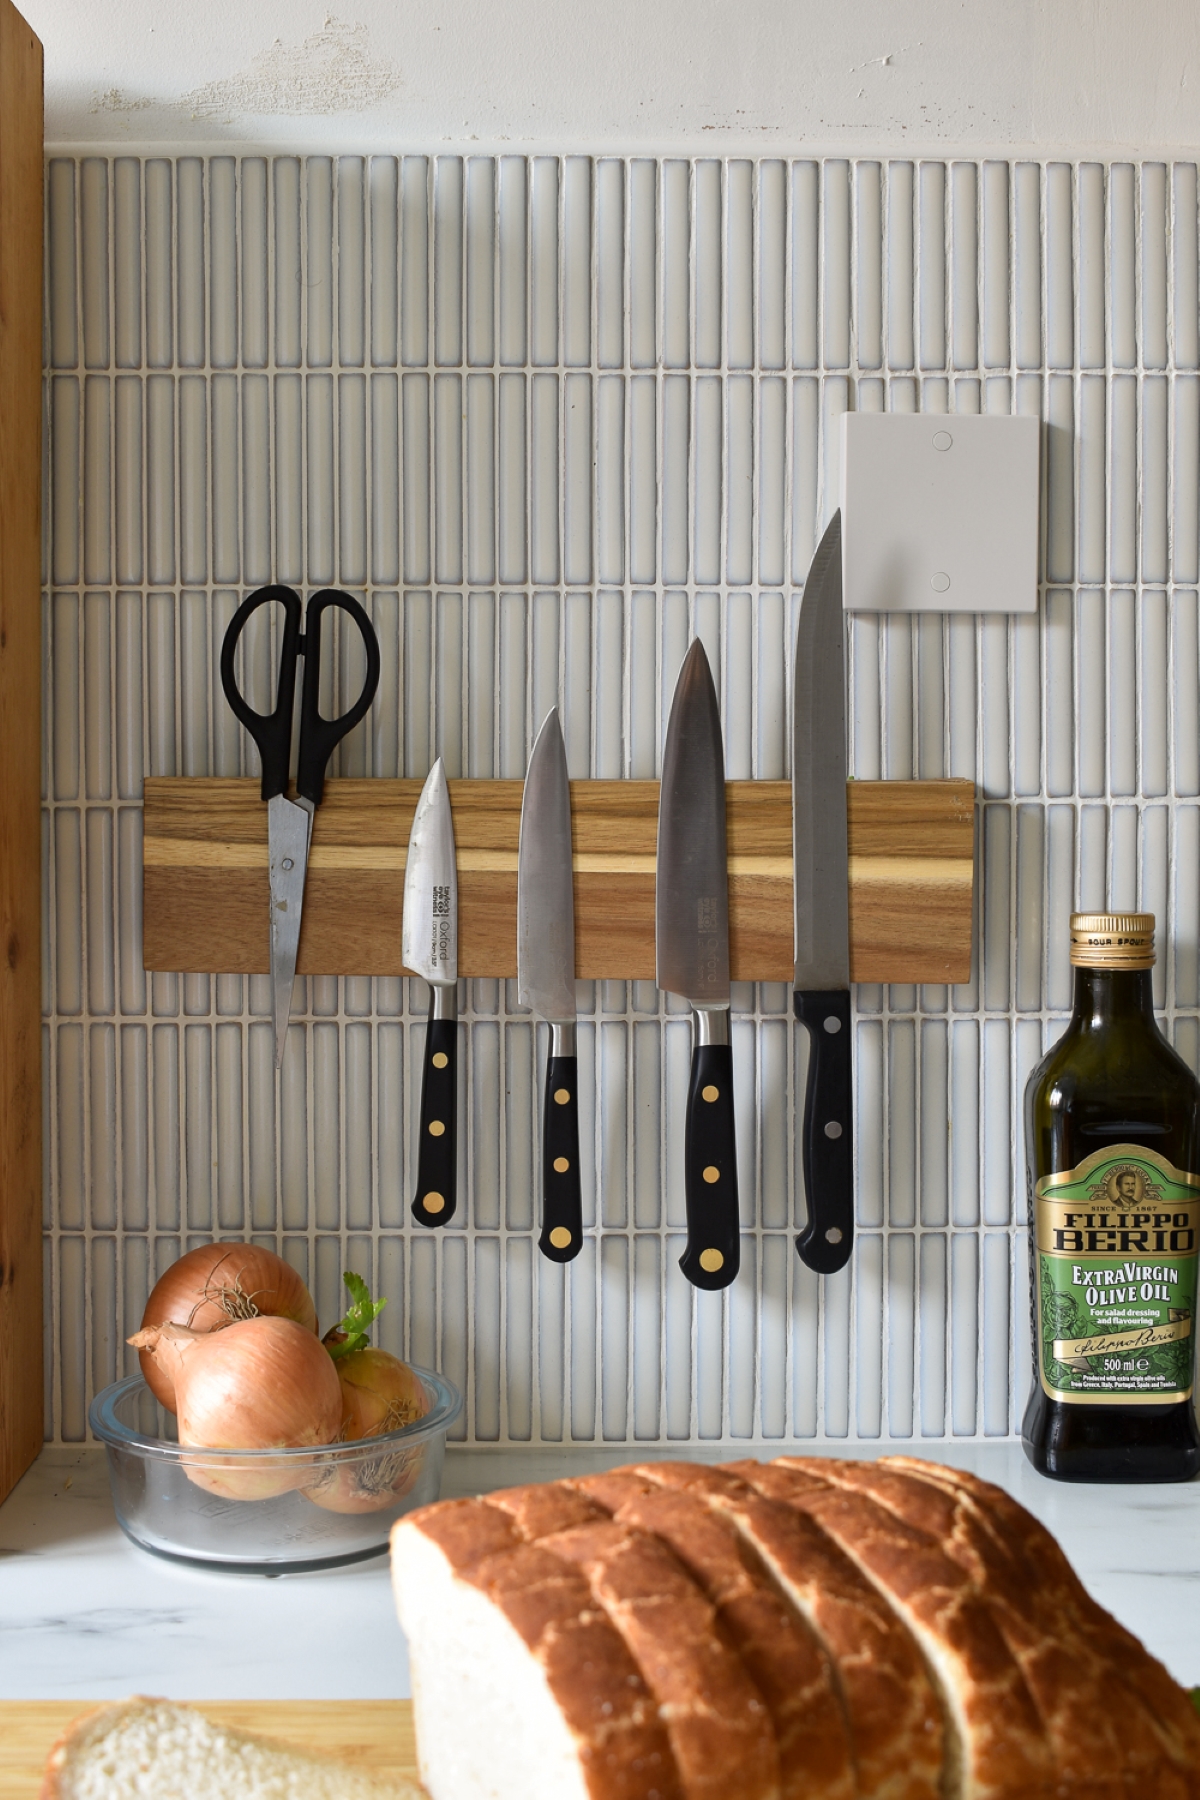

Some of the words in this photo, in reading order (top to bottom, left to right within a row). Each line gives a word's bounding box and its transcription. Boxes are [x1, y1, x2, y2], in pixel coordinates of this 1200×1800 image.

[439, 921, 451, 961] Oxford
[707, 938, 720, 982] Oxford
[1064, 1213, 1189, 1228] FILIPPO
[1053, 1228, 1194, 1252] BERIO
[1090, 1308, 1104, 1316] For
[1105, 1308, 1126, 1316] salad
[1127, 1308, 1160, 1318] dressing
[1097, 1316, 1112, 1324] and
[1113, 1316, 1154, 1327] flavouring
[1104, 1358, 1121, 1371] 500
[1123, 1358, 1135, 1371] ml
